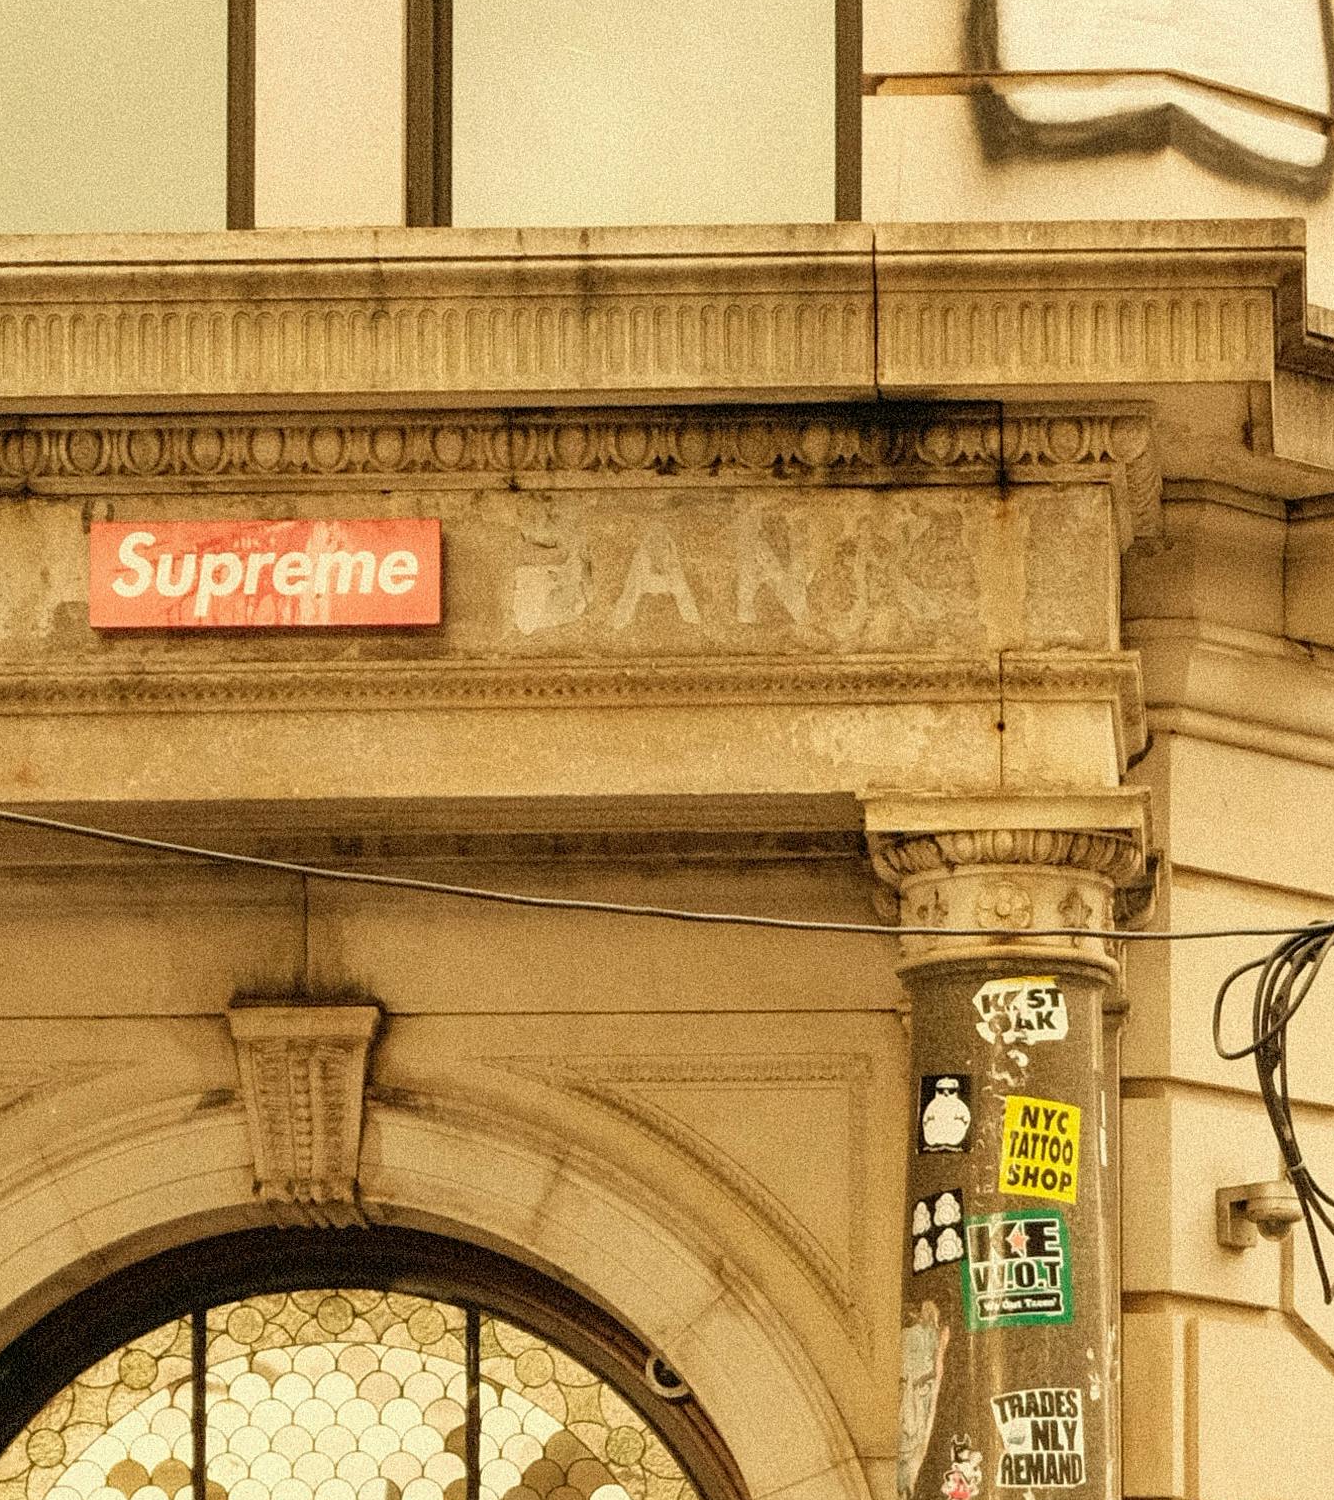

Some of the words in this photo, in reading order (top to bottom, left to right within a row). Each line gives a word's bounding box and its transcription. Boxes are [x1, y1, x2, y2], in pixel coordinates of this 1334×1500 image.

[111, 531, 419, 617] Supreme
[1021, 1106, 1069, 1132] NYC
[1009, 1132, 1073, 1167] TATTOO
[1007, 1165, 1073, 1193] SHOP
[994, 1390, 1079, 1424] TRADES
[1001, 1453, 1083, 1486] REMAND
